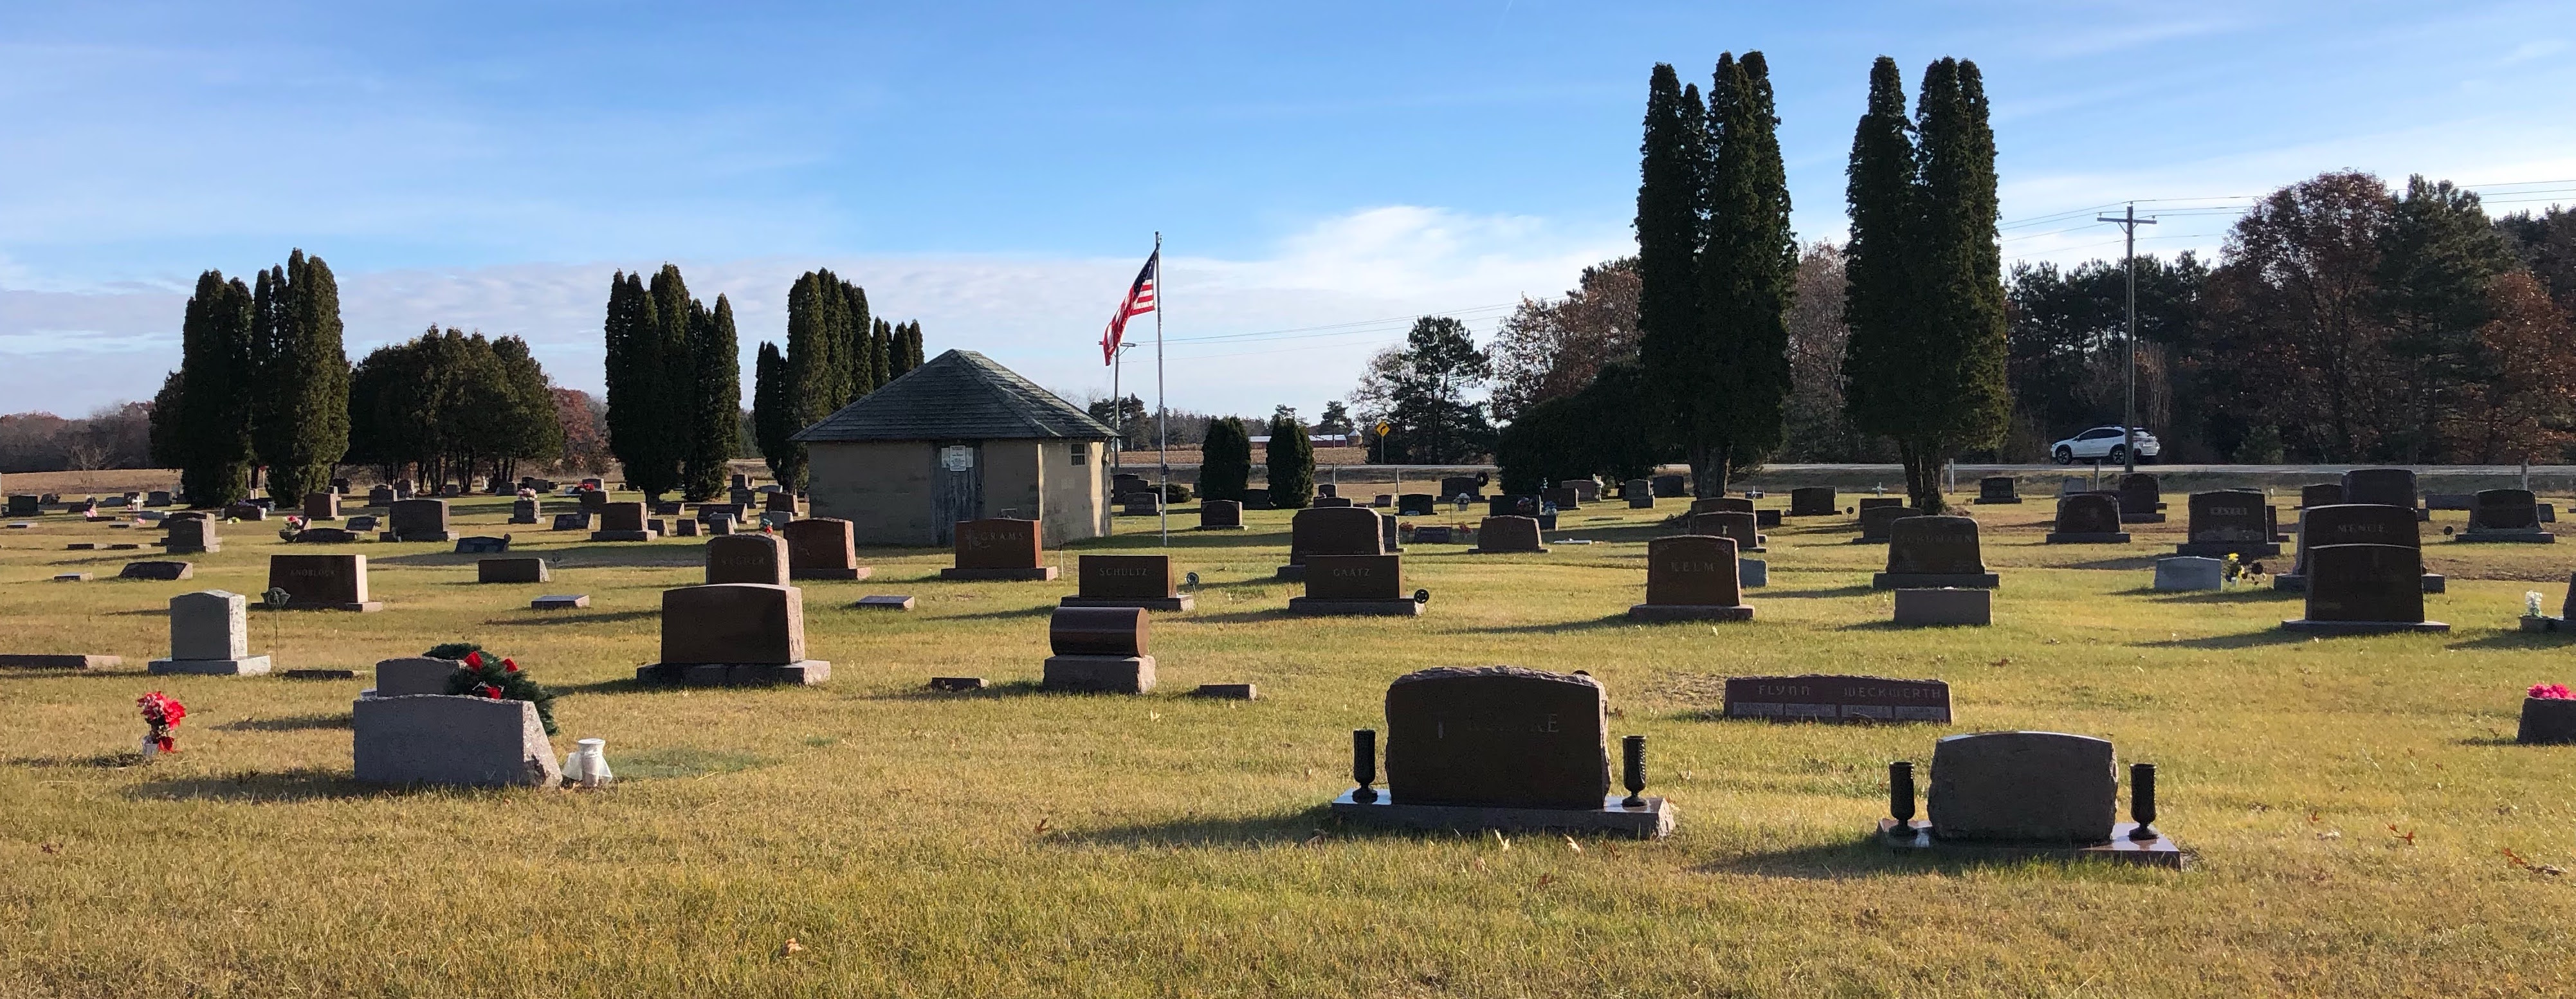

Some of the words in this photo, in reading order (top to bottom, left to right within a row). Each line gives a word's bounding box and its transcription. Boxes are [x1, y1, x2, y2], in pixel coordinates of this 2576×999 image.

[1099, 567, 1149, 576] SCHULTZ
[1671, 562, 1715, 573] KELM
[1333, 568, 1371, 577] GAATZ
